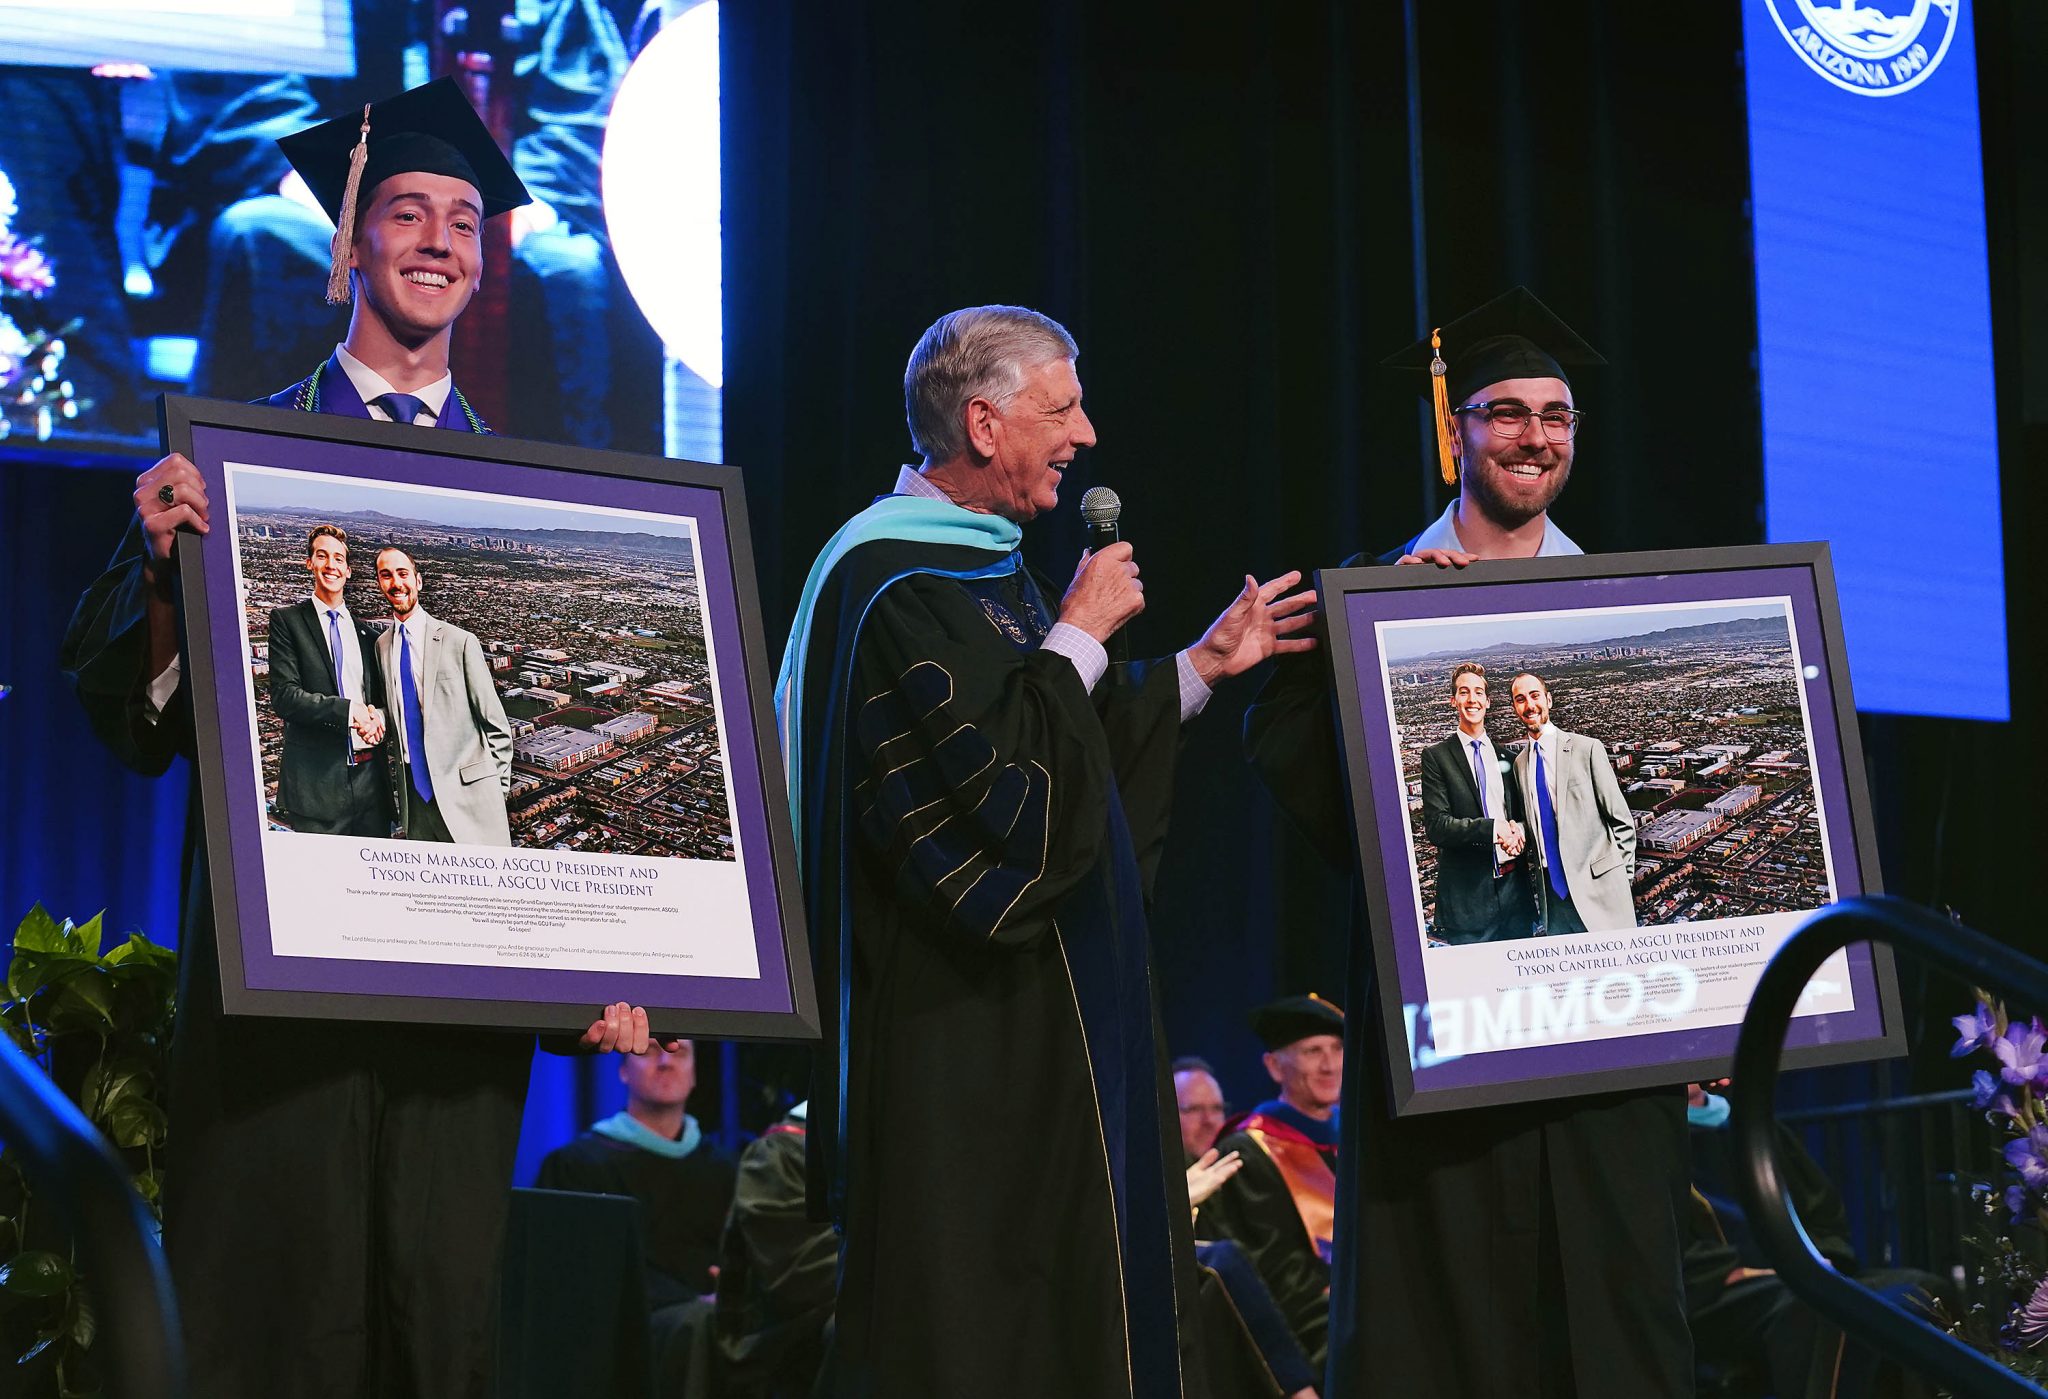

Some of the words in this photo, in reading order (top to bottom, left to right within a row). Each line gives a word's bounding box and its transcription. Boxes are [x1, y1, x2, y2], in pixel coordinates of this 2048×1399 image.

[1791, 25, 1890, 86] ARIZONA
[1890, 43, 1929, 83] 1949
[359, 848, 421, 865] CAMDEN
[426, 852, 498, 871] MARASCO,
[501, 857, 551, 873] ASGCU
[556, 861, 626, 878] PRESIDENT
[628, 867, 659, 880] AND
[368, 867, 416, 883] TYSON
[420, 870, 493, 889] CANTRELL,
[496, 875, 547, 891] ASGCU
[550, 878, 581, 893] VICE
[585, 880, 655, 897] PRESIDENT
[411, 892, 437, 901] leadership
[536, 899, 554, 907] Canyon
[553, 900, 576, 909] University
[487, 911, 508, 919] integrity
[510, 906, 541, 914] representing
[579, 909, 593, 917] being
[1506, 947, 1561, 962] CAMDEN
[1563, 940, 1626, 956] MARASCO,
[1628, 934, 1673, 950] ASGCU
[1676, 929, 1736, 945] PRESIDENT
[1738, 926, 1766, 938] AND
[1514, 963, 1556, 977] TYSON
[1558, 956, 1622, 973] CANTRELL,
[1625, 950, 1669, 966] ASGCU
[1671, 948, 1698, 961] VICE
[1701, 942, 1762, 958] PRESIDENT
